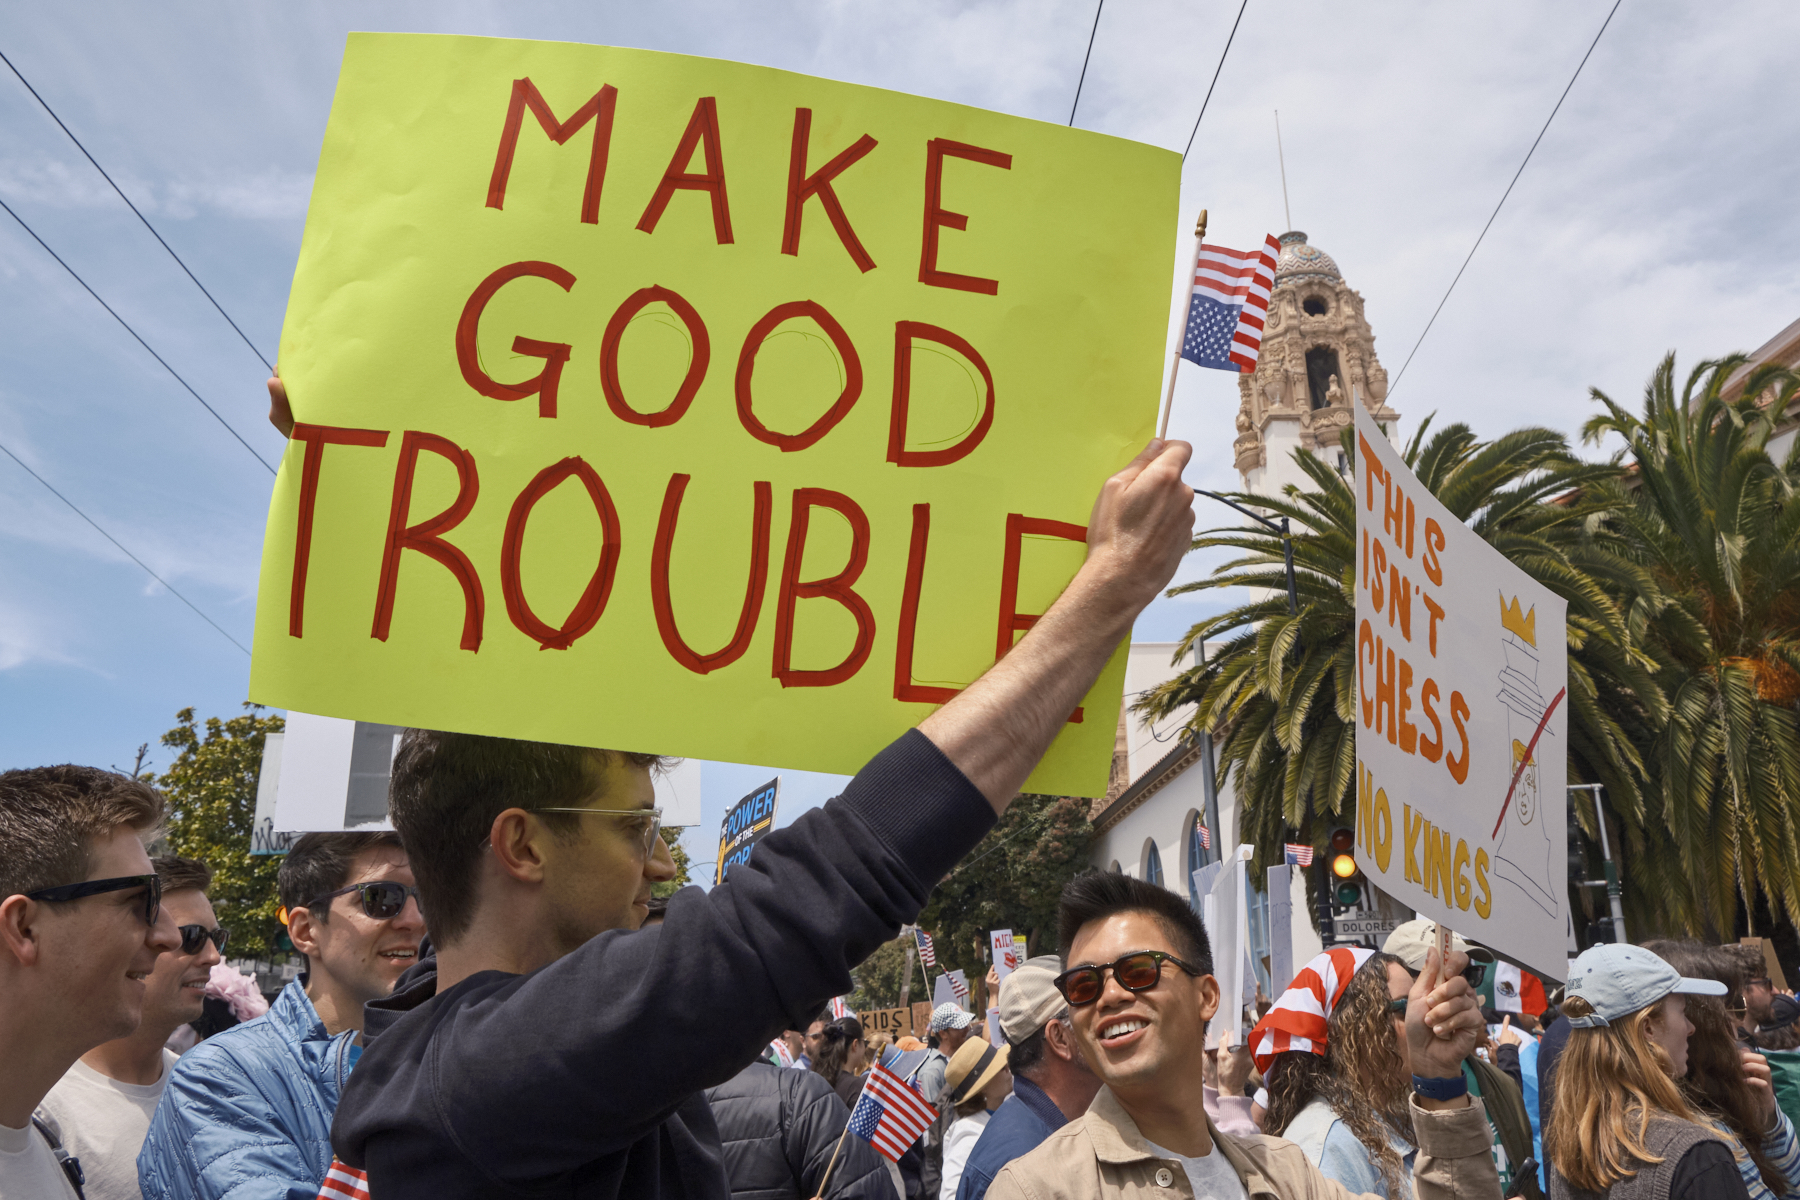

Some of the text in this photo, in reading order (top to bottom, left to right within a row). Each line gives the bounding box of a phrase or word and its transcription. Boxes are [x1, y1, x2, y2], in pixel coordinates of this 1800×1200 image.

[485, 76, 1013, 296] MAKE
[455, 260, 995, 468] GOOD
[289, 421, 1088, 724] TROUBLE
[1358, 430, 1447, 588] THIS
[1363, 526, 1446, 659] ISN'T
[1358, 617, 1471, 785] CHESS
[727, 787, 775, 842] POWER
[734, 825, 754, 846] OF THE
[1357, 760, 1493, 920] NO KINGS
[1016, 955, 1024, 965] 5
[1342, 922, 1396, 932] DOLORES
[861, 1010, 904, 1030] KIDS
